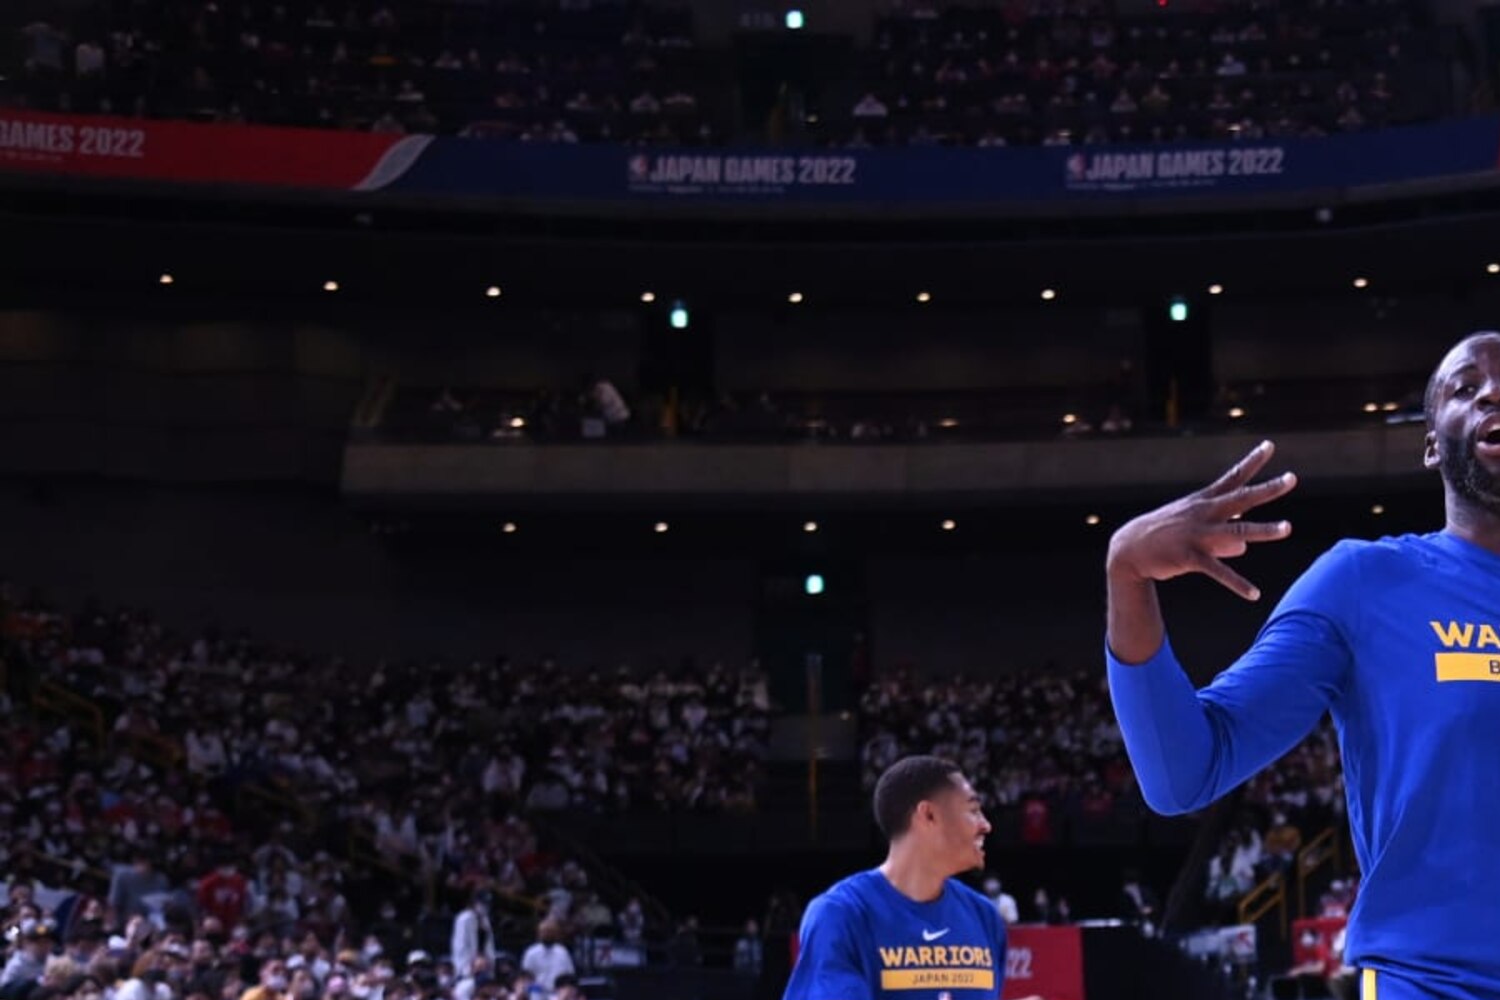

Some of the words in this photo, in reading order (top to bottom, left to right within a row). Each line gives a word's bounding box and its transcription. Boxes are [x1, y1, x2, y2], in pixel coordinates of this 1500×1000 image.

[79, 126, 146, 158] 2022
[650, 155, 721, 183] JAPAN
[724, 155, 795, 184] GAMES
[798, 157, 857, 185] 2022
[1086, 151, 1154, 181] JAPAN
[1156, 149, 1225, 178] GAMES
[1228, 146, 1286, 175] 2022
[879, 945, 994, 968] WARRIORS
[912, 972, 949, 985] JAPAN
